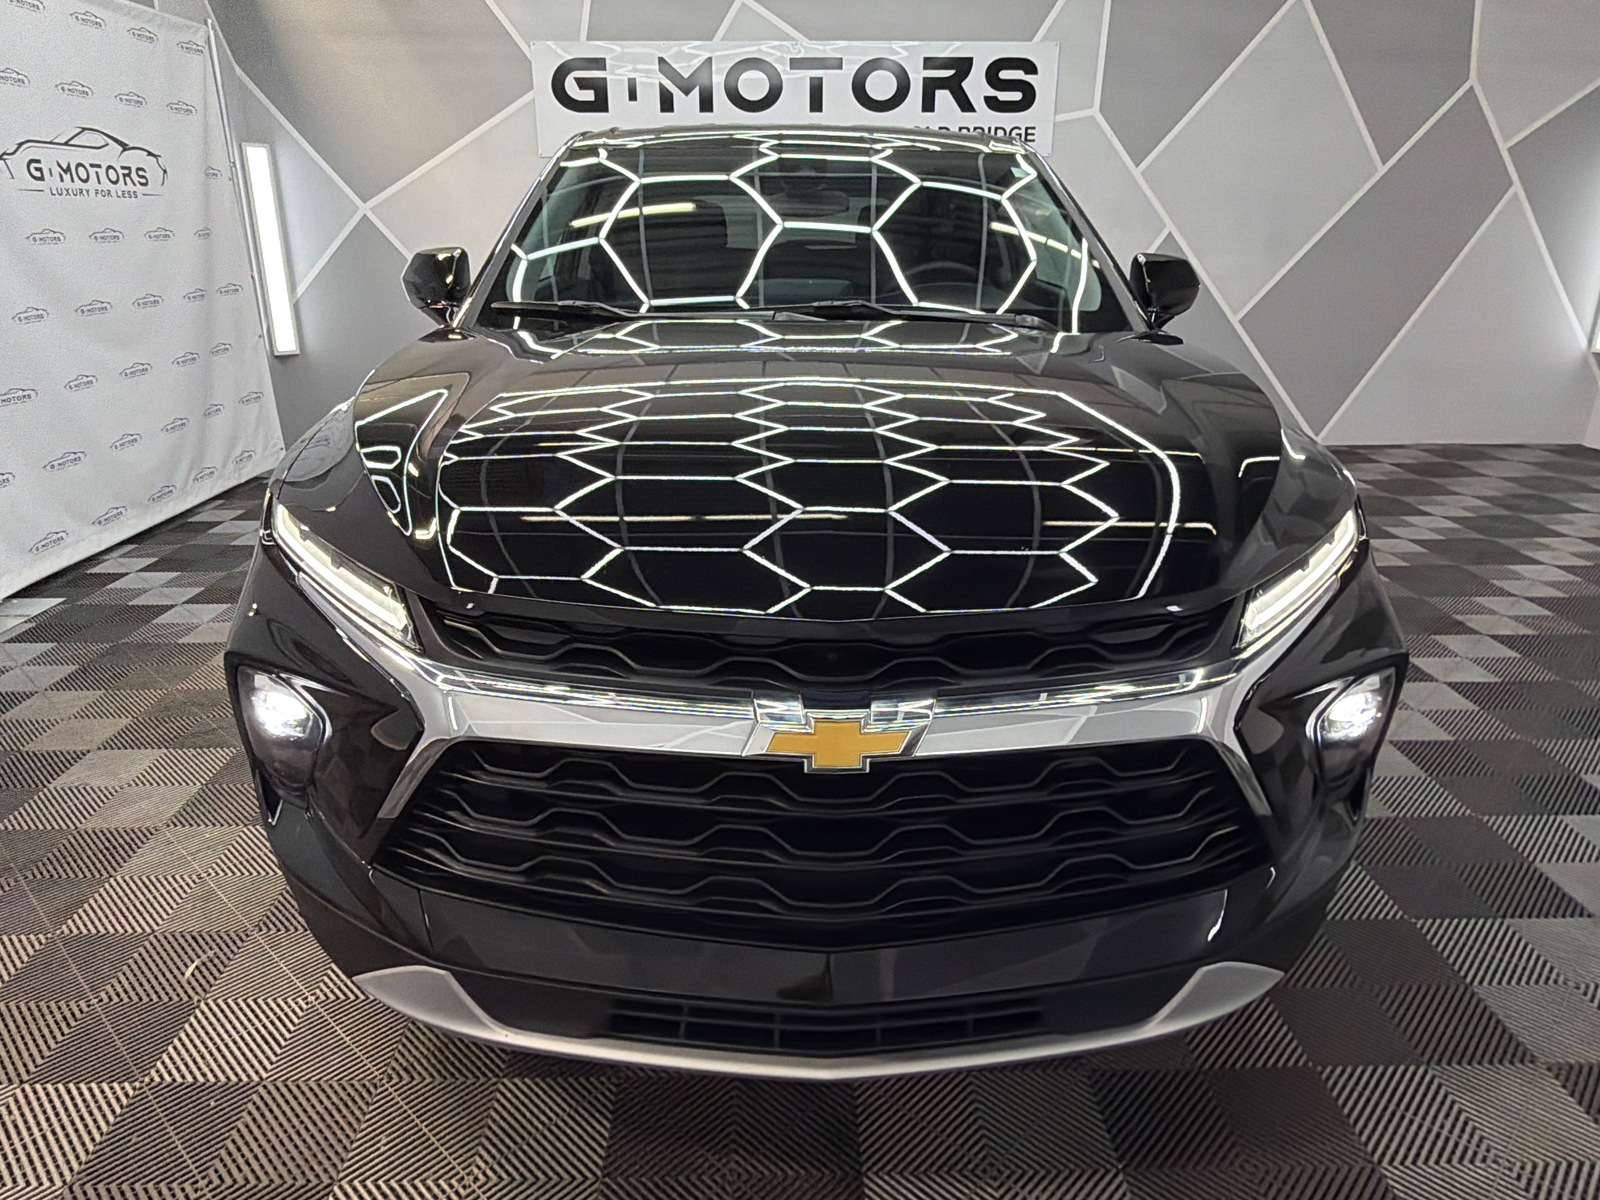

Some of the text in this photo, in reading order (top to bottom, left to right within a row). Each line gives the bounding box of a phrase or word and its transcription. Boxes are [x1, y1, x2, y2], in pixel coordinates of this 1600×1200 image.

[50, 187, 138, 199] LUXURY FOR LESS
